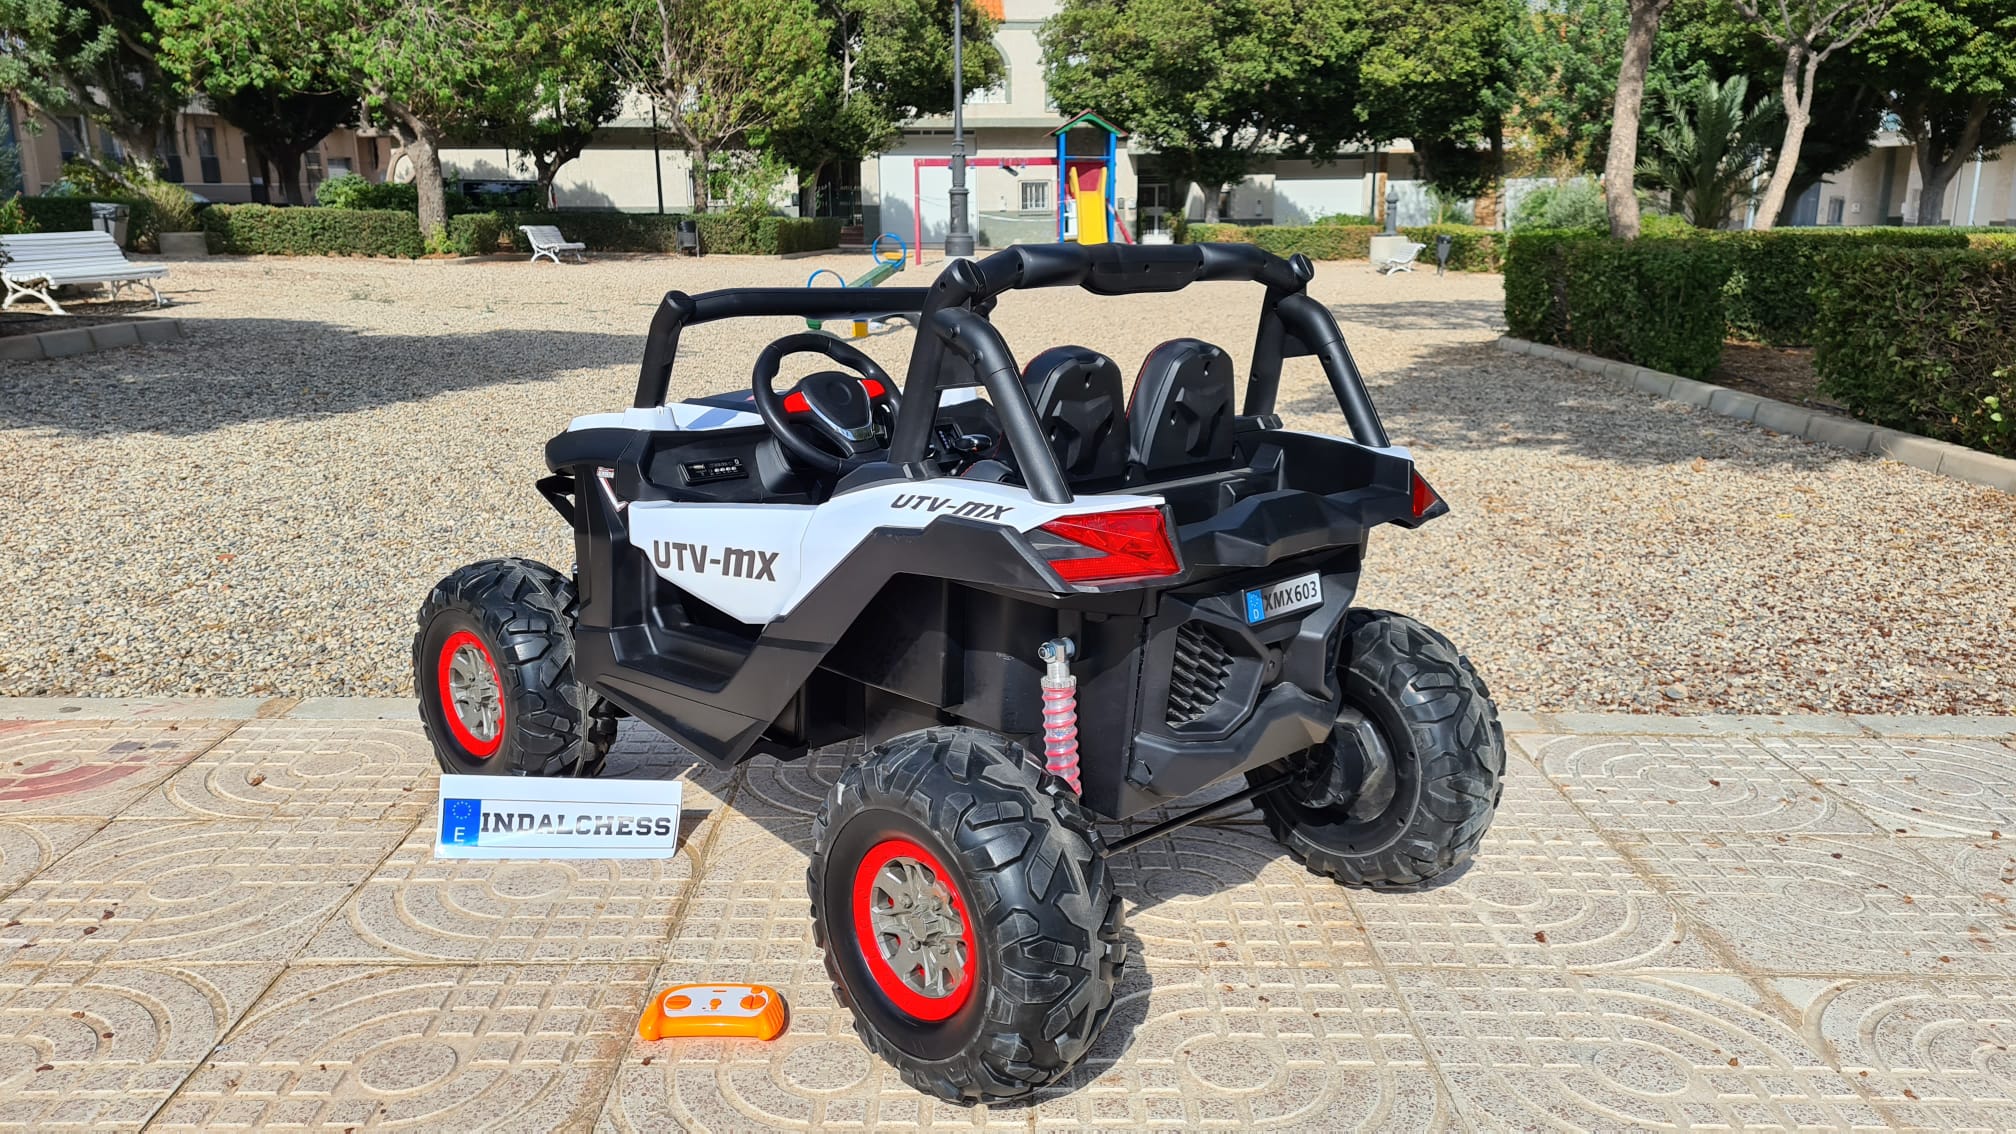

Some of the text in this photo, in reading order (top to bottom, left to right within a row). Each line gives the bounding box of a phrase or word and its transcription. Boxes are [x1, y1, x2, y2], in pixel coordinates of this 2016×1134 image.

[1264, 580, 1317, 611] XMX603
[1252, 608, 1260, 620] D
[481, 812, 671, 836] INDALCHESS
[454, 826, 466, 843] E
